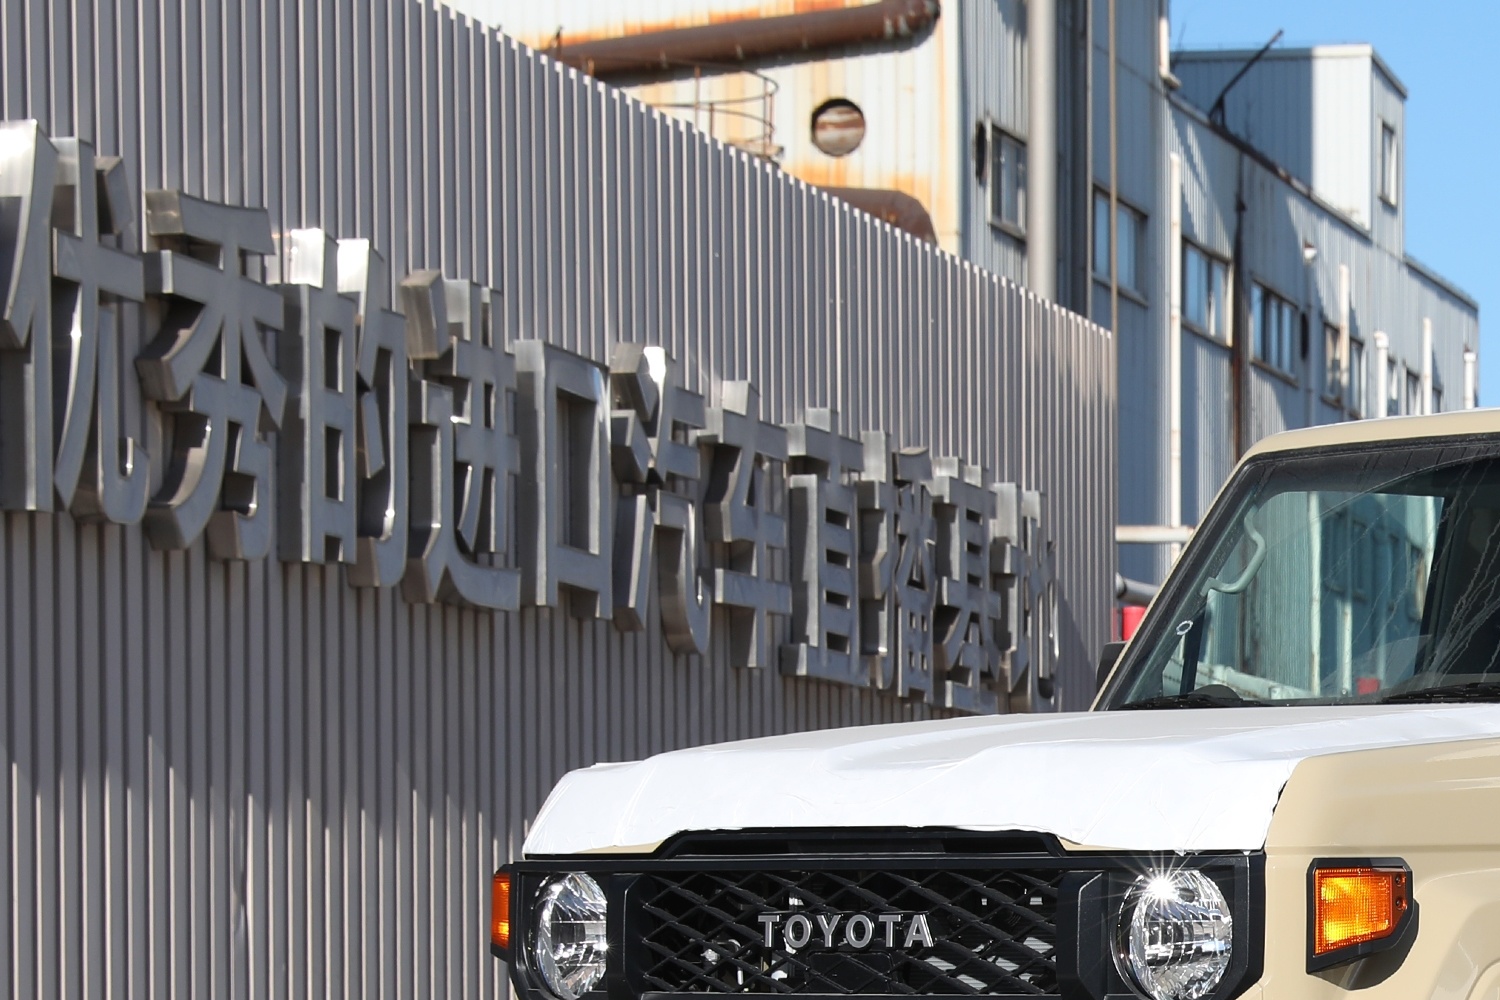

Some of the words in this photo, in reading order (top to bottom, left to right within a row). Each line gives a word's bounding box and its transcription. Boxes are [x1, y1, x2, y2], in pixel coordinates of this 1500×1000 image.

[0, 118, 1060, 712] 优秀的进口汽车直播基地
[757, 913, 934, 948] TOYOTA
